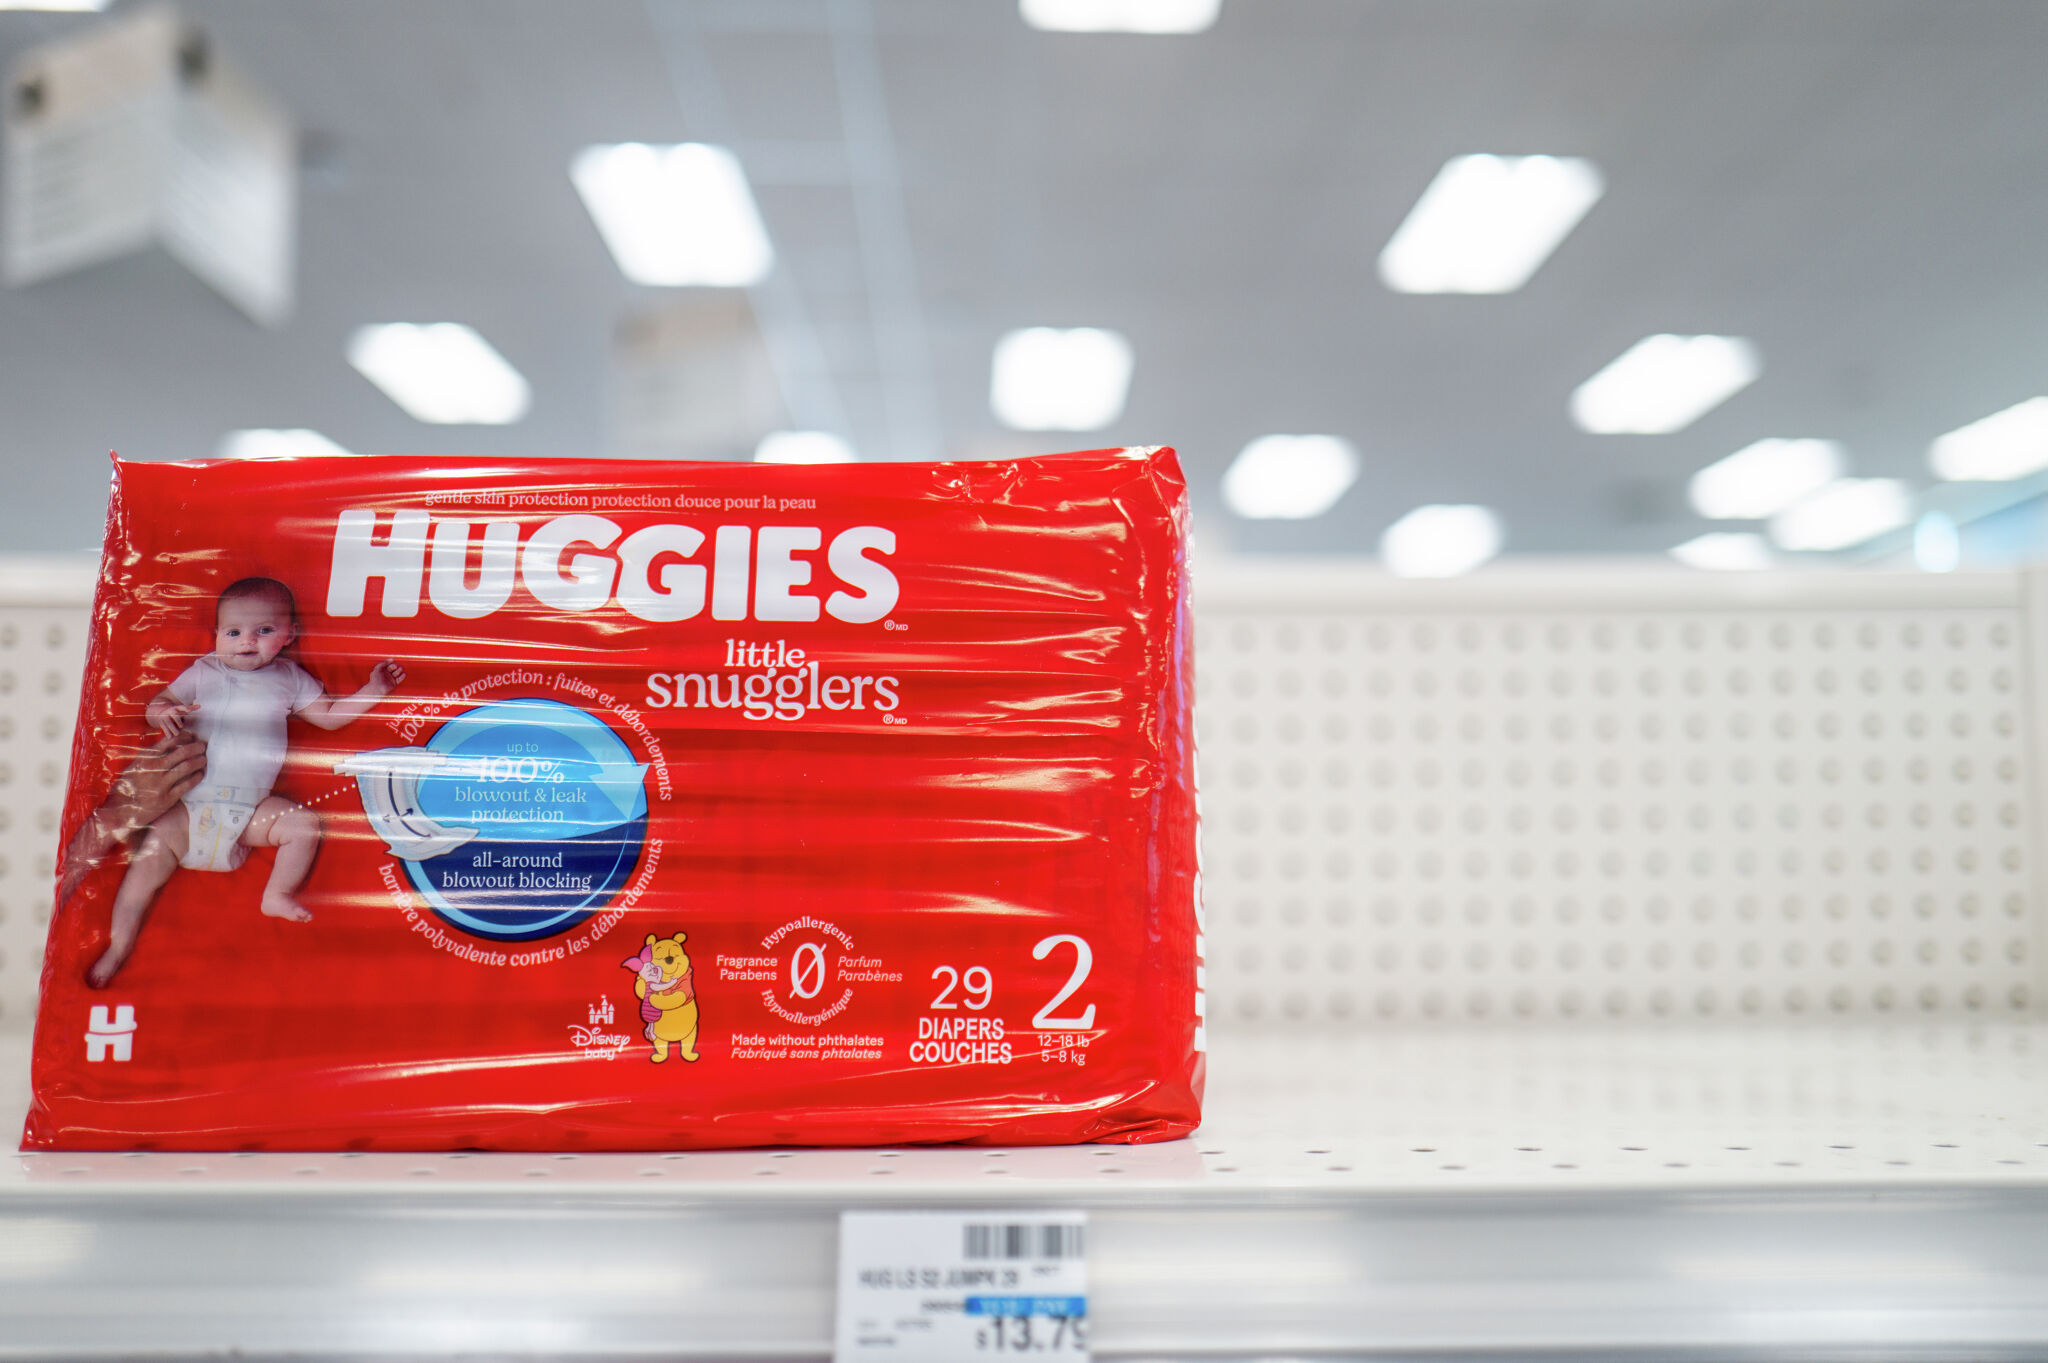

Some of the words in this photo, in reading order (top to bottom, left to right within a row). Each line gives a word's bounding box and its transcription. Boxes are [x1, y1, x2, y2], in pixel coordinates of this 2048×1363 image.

[425, 491, 472, 506] gentle
[474, 491, 506, 504] skin
[509, 492, 588, 508] protection
[592, 494, 671, 508] protection
[675, 494, 721, 508] douce
[724, 498, 760, 512] pour
[763, 495, 776, 509] la
[779, 498, 816, 512] peau
[325, 510, 900, 624] HUGGIES
[724, 638, 806, 668] little
[645, 661, 899, 721] snugglers
[441, 692, 460, 709] de
[461, 668, 542, 701] protection
[553, 673, 599, 699] fuites
[599, 693, 616, 708] et
[613, 704, 673, 801] débordements
[507, 743, 523, 754] up
[526, 742, 539, 753] to
[477, 756, 565, 783] 100%
[455, 786, 530, 802] blowout
[535, 788, 547, 803] &
[552, 787, 587, 803] leak
[472, 807, 564, 824] protection
[472, 851, 563, 868] all-around
[442, 872, 515, 888] blowout
[518, 872, 593, 892] blocking
[412, 919, 507, 966] polyvalente
[510, 946, 565, 967] contre
[566, 936, 590, 955] les
[591, 837, 664, 941] débordements
[761, 915, 854, 951] Hypoallergenic
[716, 954, 778, 969] Fragrance
[837, 956, 882, 968] Parfum
[719, 968, 777, 981] Parabens
[837, 969, 903, 982] Parabènes
[1032, 934, 1096, 1029] 2
[930, 965, 993, 1010] 29
[761, 988, 854, 1026] Hypoallergénique
[918, 1017, 1005, 1040] DIAPERS
[731, 1033, 766, 1046] Made
[769, 1033, 815, 1046] without
[818, 1034, 884, 1048] phthalates
[1077, 1035, 1090, 1048] lb
[585, 1048, 615, 1060] baby
[731, 1047, 787, 1060] Fabriqué
[789, 1050, 819, 1059] sans
[821, 1048, 882, 1061] phtalates
[909, 1041, 1013, 1065] COUCHES
[1071, 1051, 1086, 1066] kg
